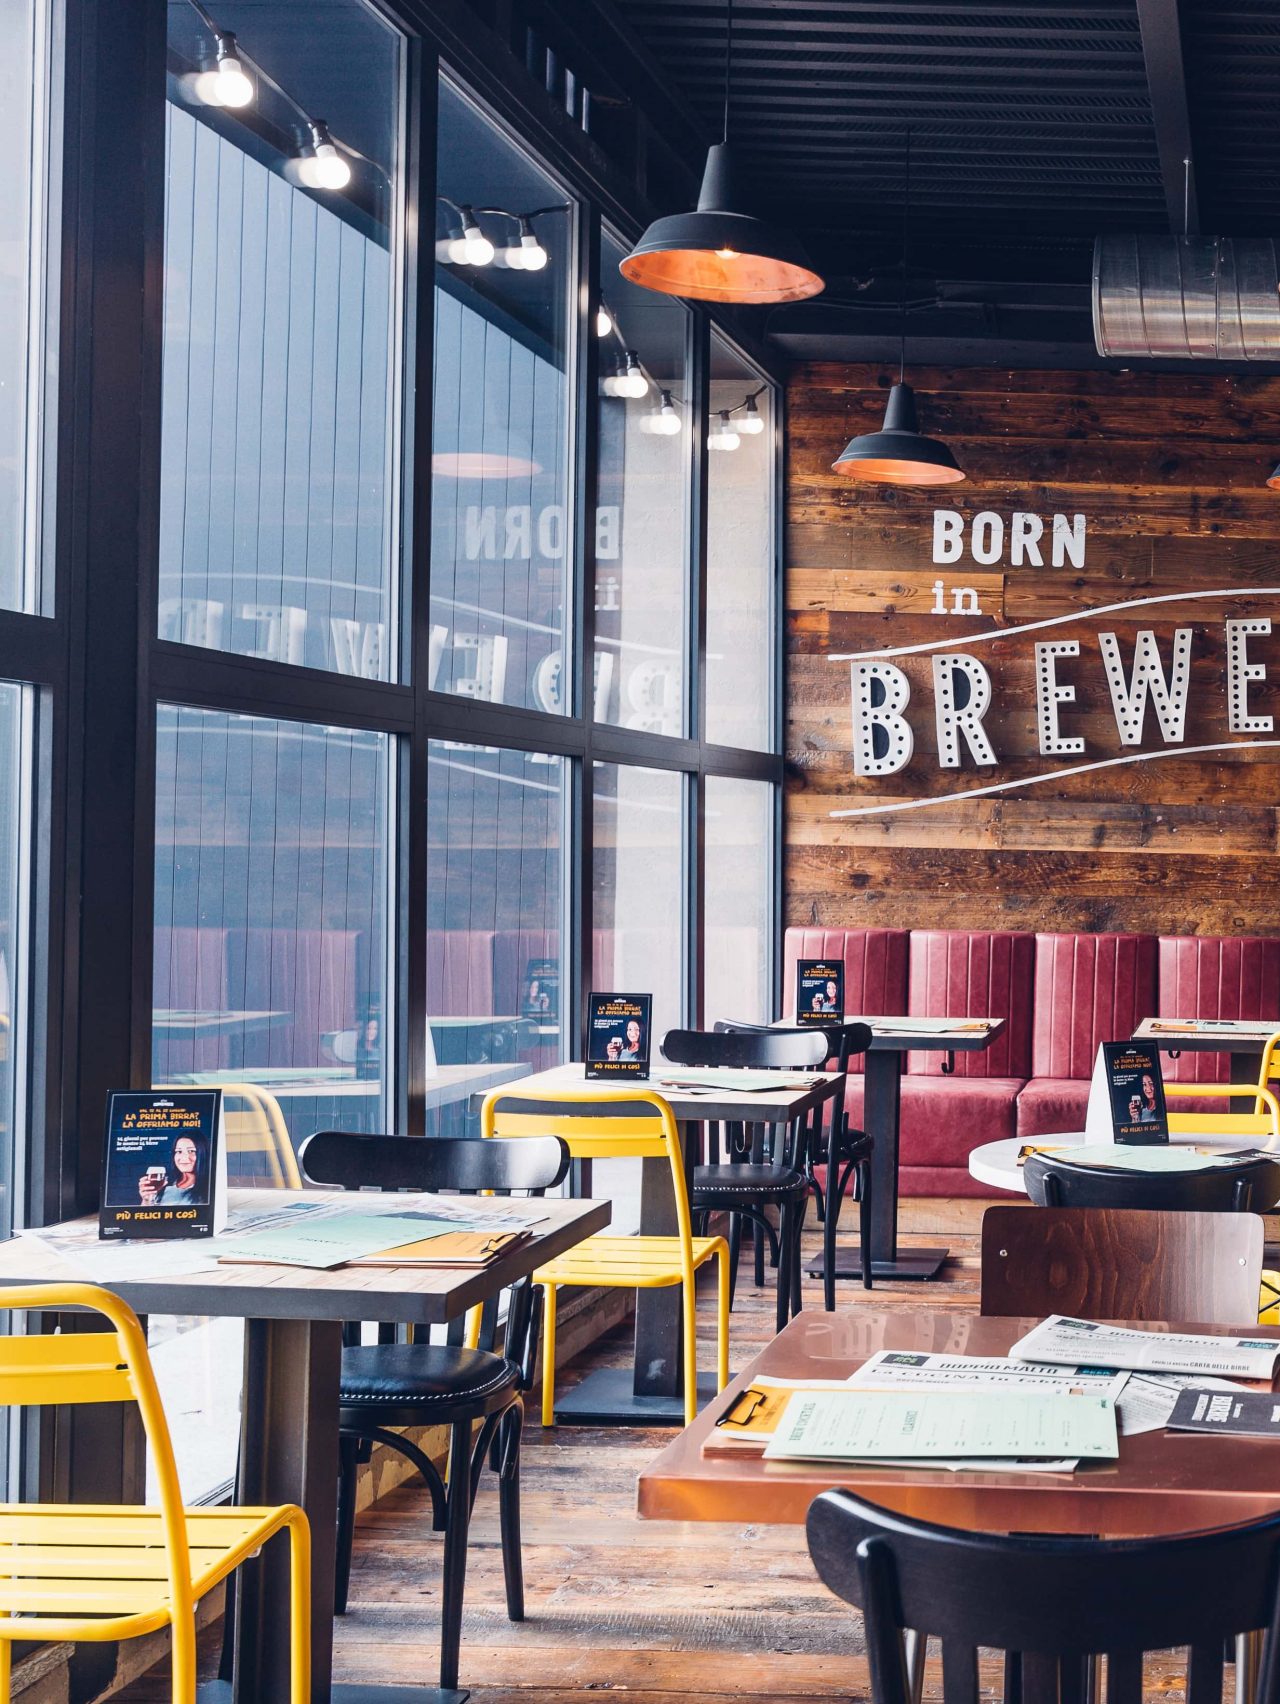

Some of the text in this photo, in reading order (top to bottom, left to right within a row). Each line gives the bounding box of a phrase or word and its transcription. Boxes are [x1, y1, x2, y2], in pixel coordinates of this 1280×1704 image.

[933, 509, 1087, 569] BORN
[931, 580, 982, 616] in
[125, 1113, 136, 1121] LA
[170, 1112, 200, 1120] BIRRA?
[122, 1119, 201, 1128] LA OFFRIAMO NOI!
[116, 1209, 197, 1220] PIÙ FELICI DI COSÌ
